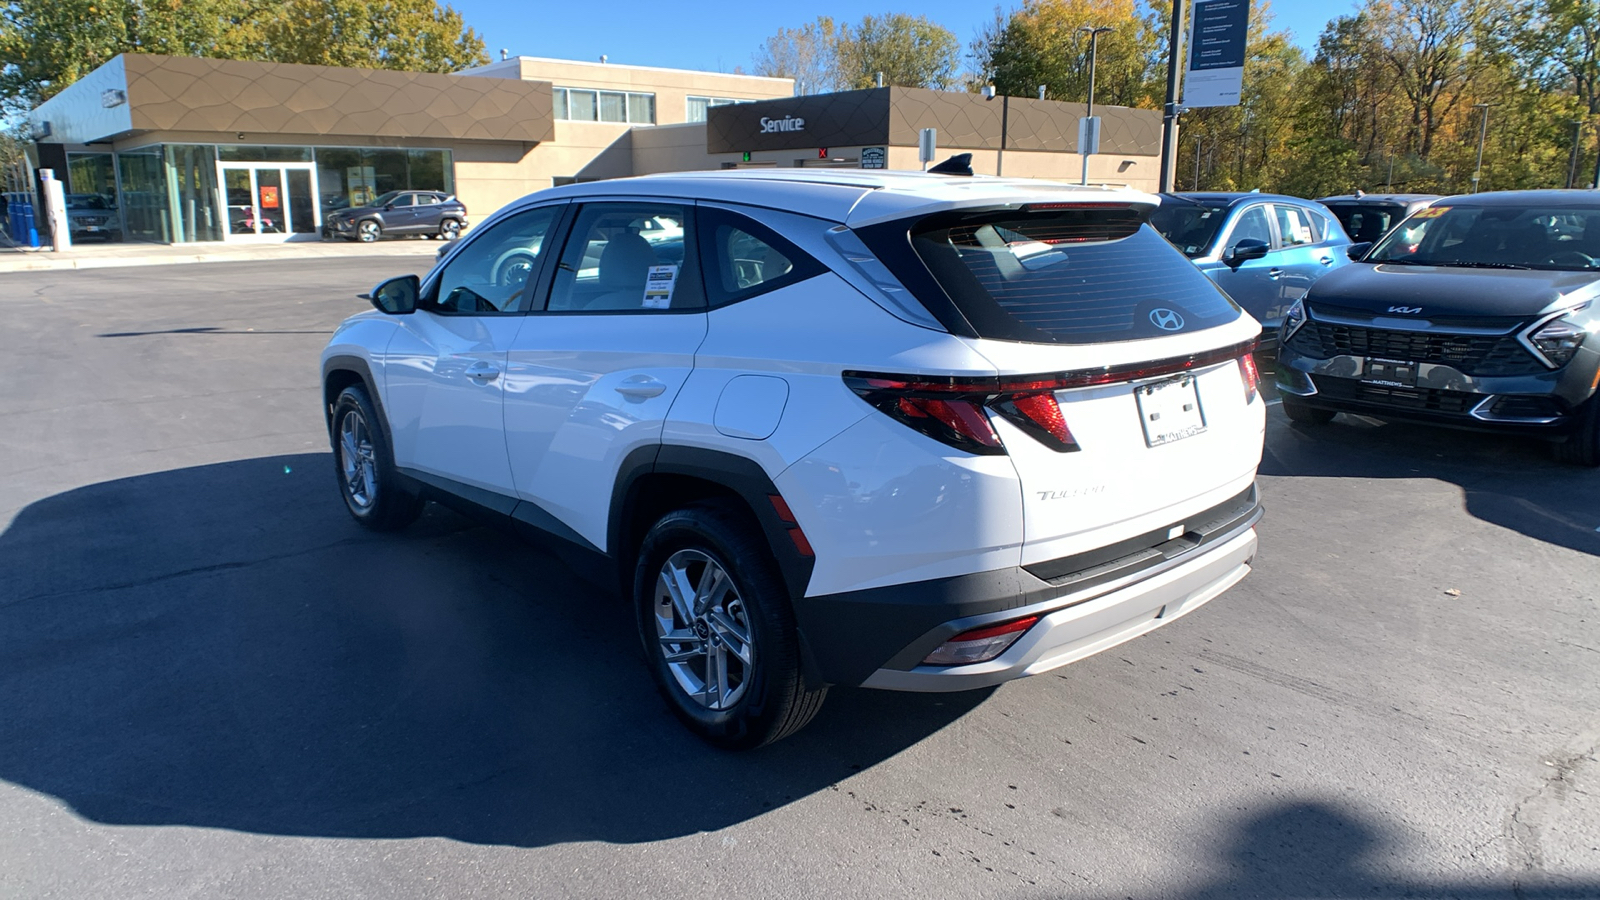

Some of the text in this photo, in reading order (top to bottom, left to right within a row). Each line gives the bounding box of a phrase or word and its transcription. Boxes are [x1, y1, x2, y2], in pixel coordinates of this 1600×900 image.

[760, 115, 805, 133] Service
[1388, 306, 1422, 314] KIA
[1372, 379, 1403, 387] MATTHEWS
